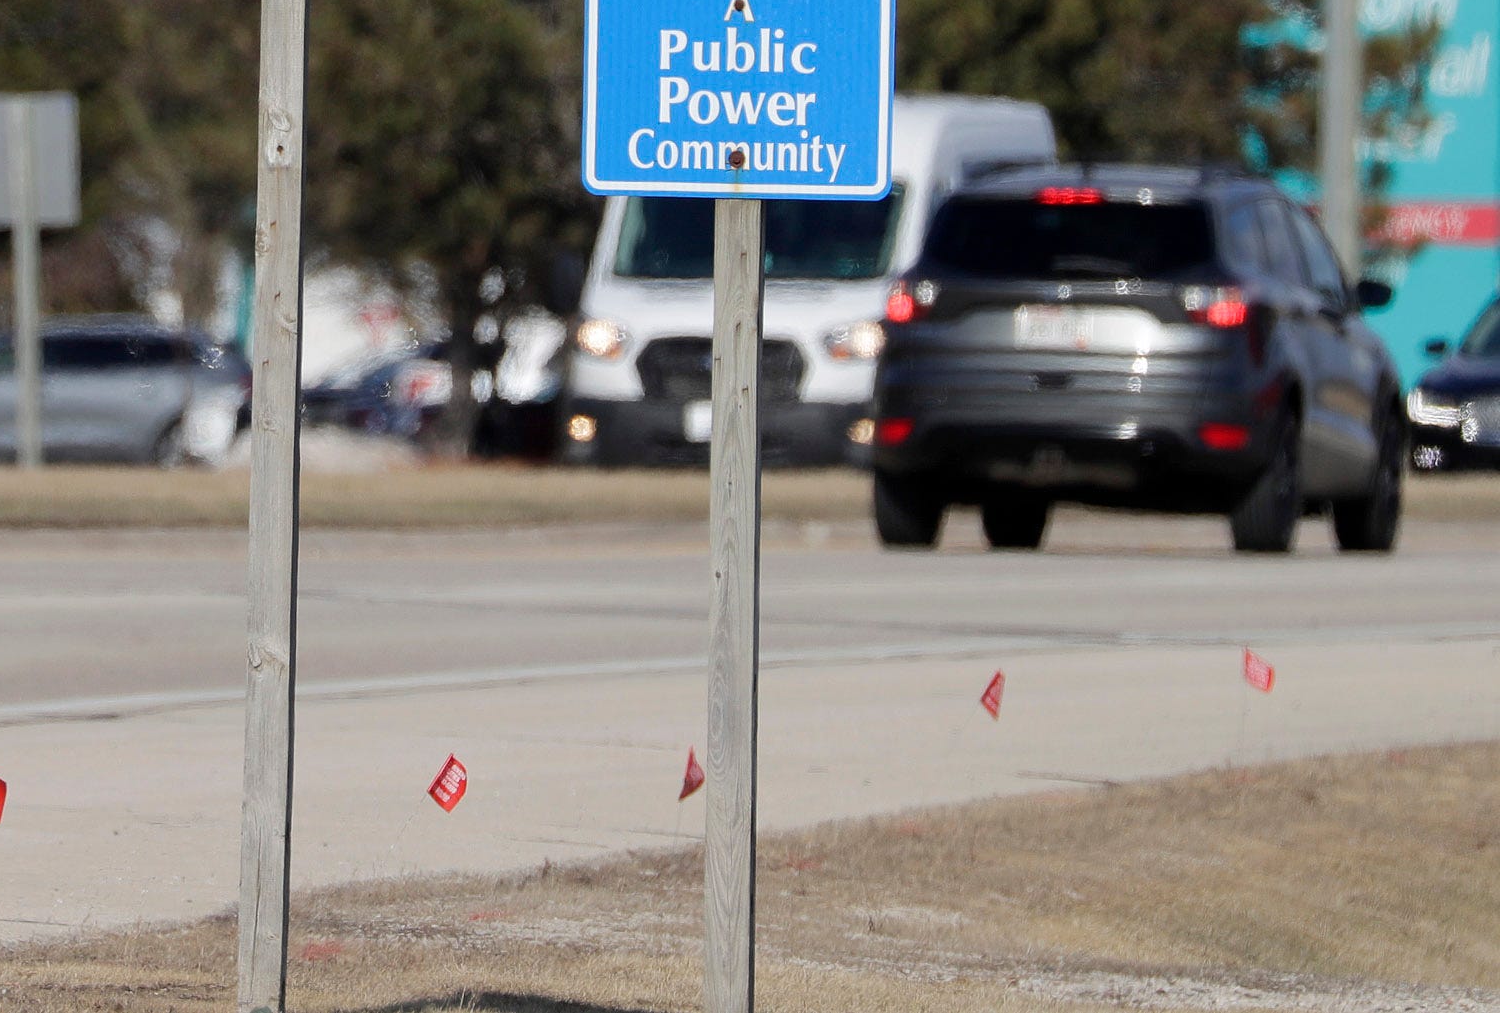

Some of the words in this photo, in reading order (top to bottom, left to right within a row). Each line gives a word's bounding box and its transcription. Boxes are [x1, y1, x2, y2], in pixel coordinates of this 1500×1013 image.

[659, 26, 818, 75] Public
[658, 76, 817, 126] Power
[627, 128, 847, 183] Community
